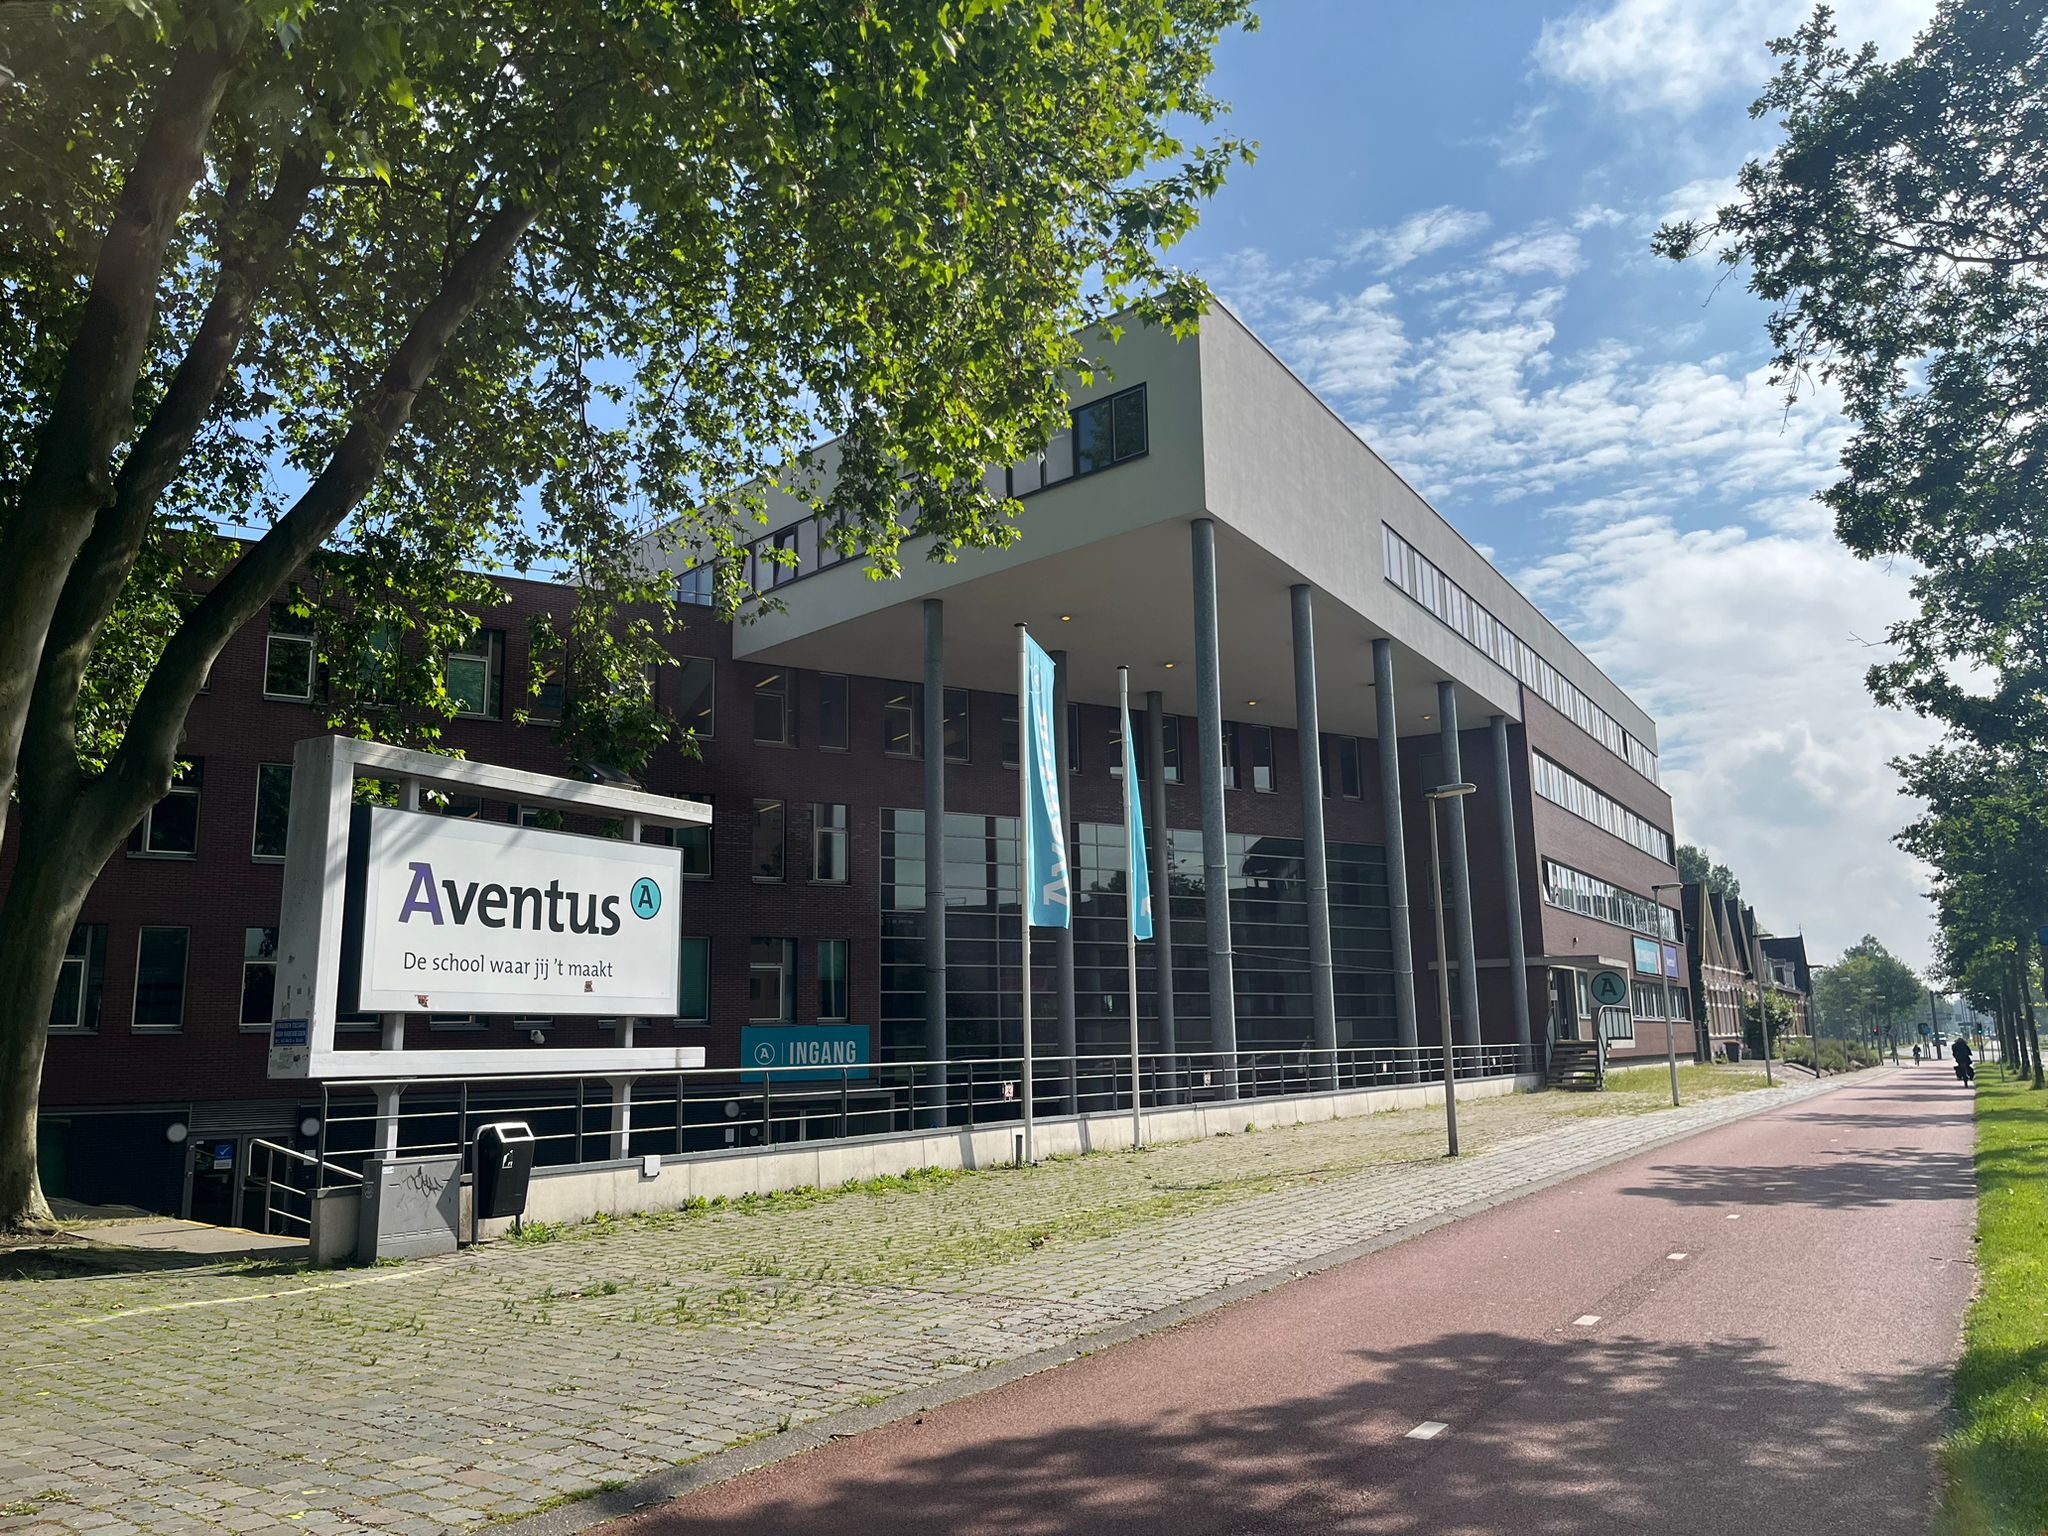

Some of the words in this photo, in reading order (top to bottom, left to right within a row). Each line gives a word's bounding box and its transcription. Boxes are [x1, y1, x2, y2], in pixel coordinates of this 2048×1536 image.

[398, 861, 621, 936] Aventus
[638, 885, 653, 909] A
[403, 952, 427, 970] De
[432, 953, 484, 973] school
[490, 960, 531, 975] waar
[533, 959, 549, 980] jij
[568, 961, 613, 978] maakt
[1601, 978, 1618, 996] A
[760, 1048, 769, 1059] A
[789, 1040, 856, 1065] INGANG
